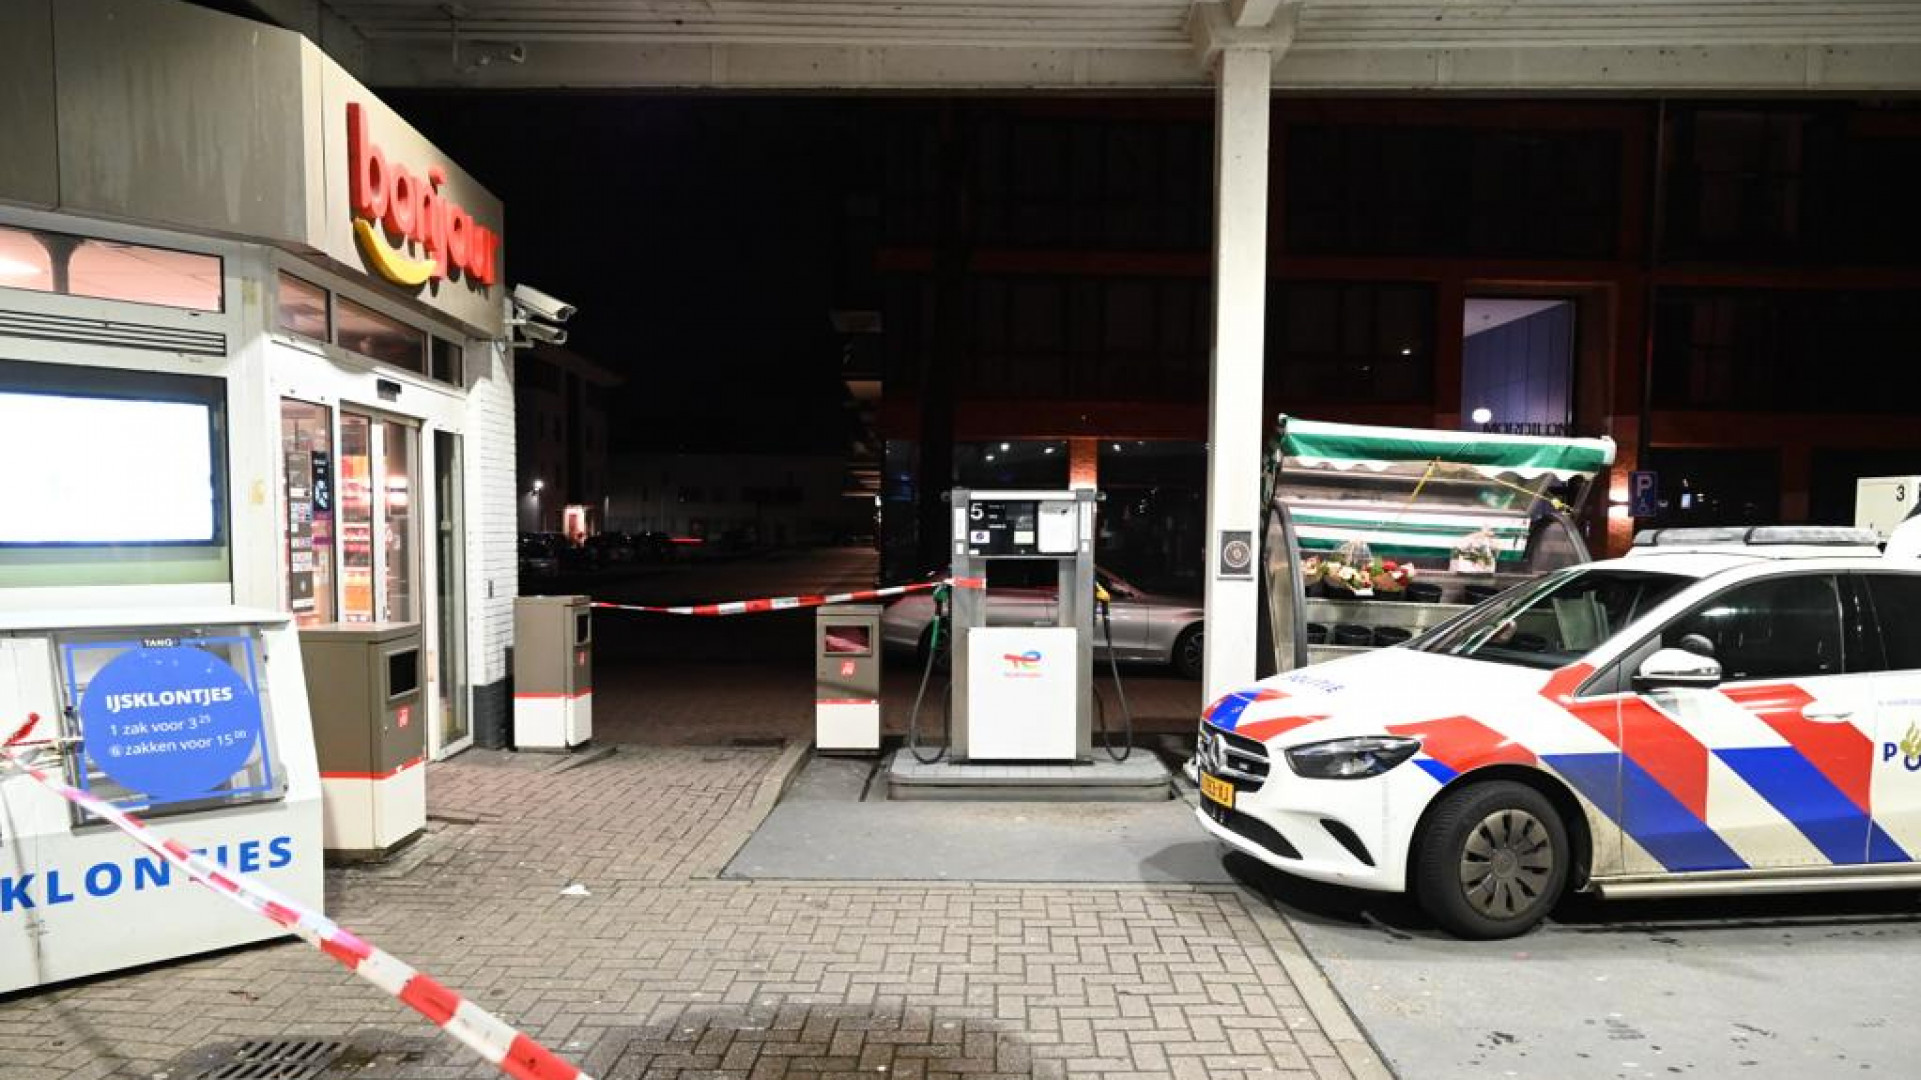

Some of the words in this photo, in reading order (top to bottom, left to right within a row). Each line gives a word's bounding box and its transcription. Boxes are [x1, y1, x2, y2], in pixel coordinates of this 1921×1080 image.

[346, 102, 499, 285] bonjour
[1637, 475, 1653, 497] P
[1896, 485, 1905, 502] 3
[970, 503, 984, 520] 5
[105, 686, 233, 713] IJSKLONTJES
[110, 724, 118, 737] 1
[122, 722, 148, 736] zak
[151, 719, 185, 733] voor
[125, 740, 177, 757] zakken
[180, 737, 213, 751] voor
